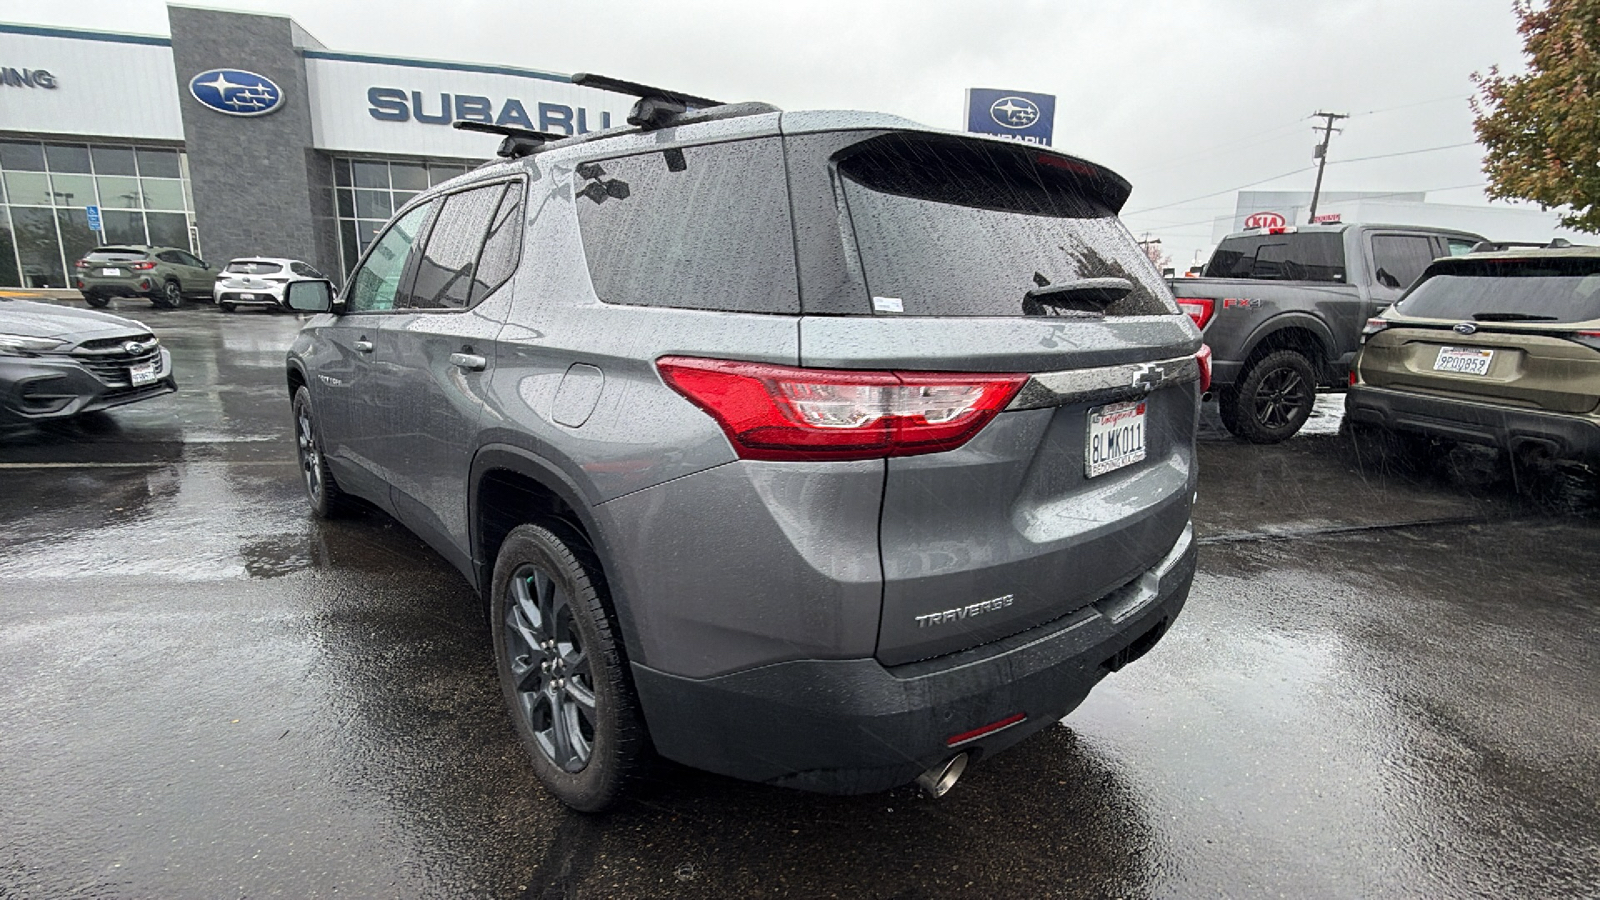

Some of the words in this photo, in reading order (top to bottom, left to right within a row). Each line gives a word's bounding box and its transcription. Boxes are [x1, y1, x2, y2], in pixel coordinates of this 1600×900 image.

[0, 67, 57, 89] ING
[1252, 216, 1278, 228] KIA
[1223, 298, 1261, 308] FX4
[1092, 423, 1142, 464] 8LMK011
[915, 594, 1014, 628] TRAVERSE
